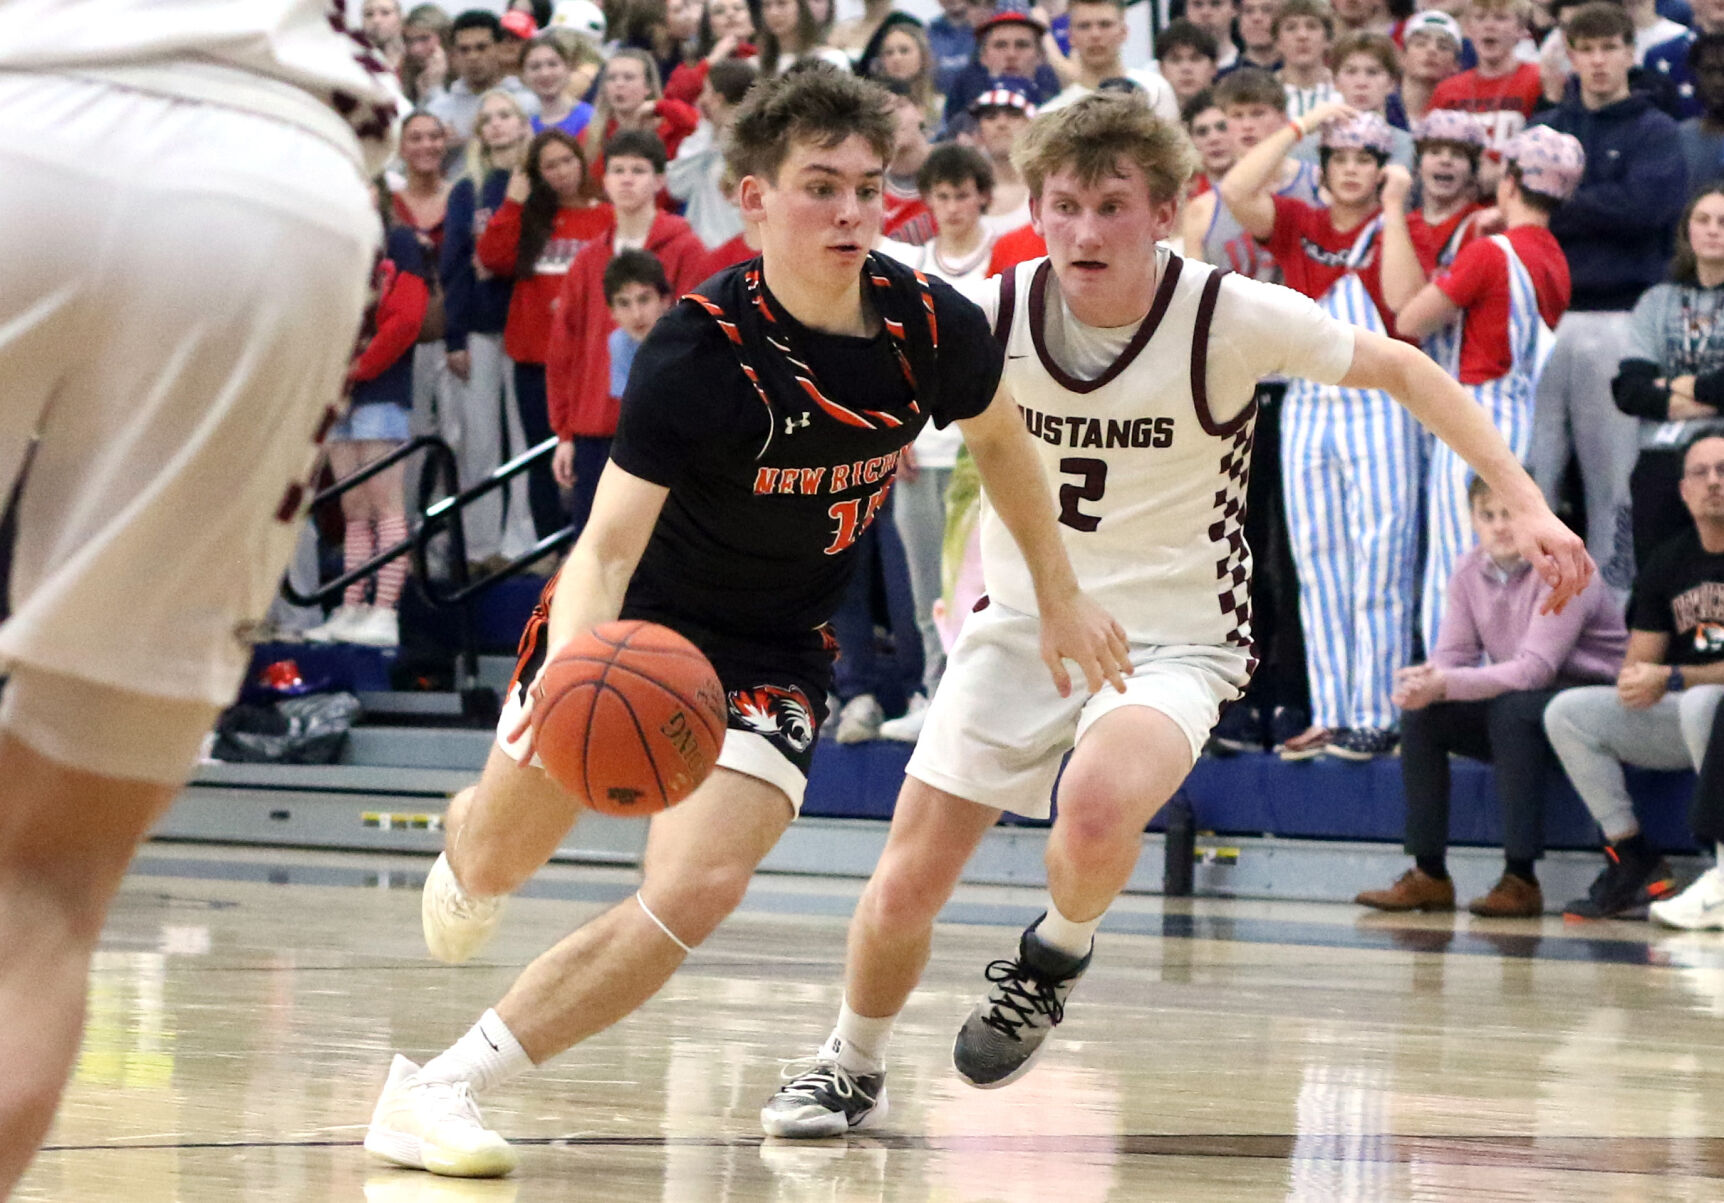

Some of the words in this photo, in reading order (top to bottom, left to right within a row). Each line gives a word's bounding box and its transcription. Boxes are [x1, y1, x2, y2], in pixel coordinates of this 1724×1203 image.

[1018, 403, 1174, 448] USTANGS
[754, 467, 826, 495] NEW
[1057, 457, 1108, 532] 2
